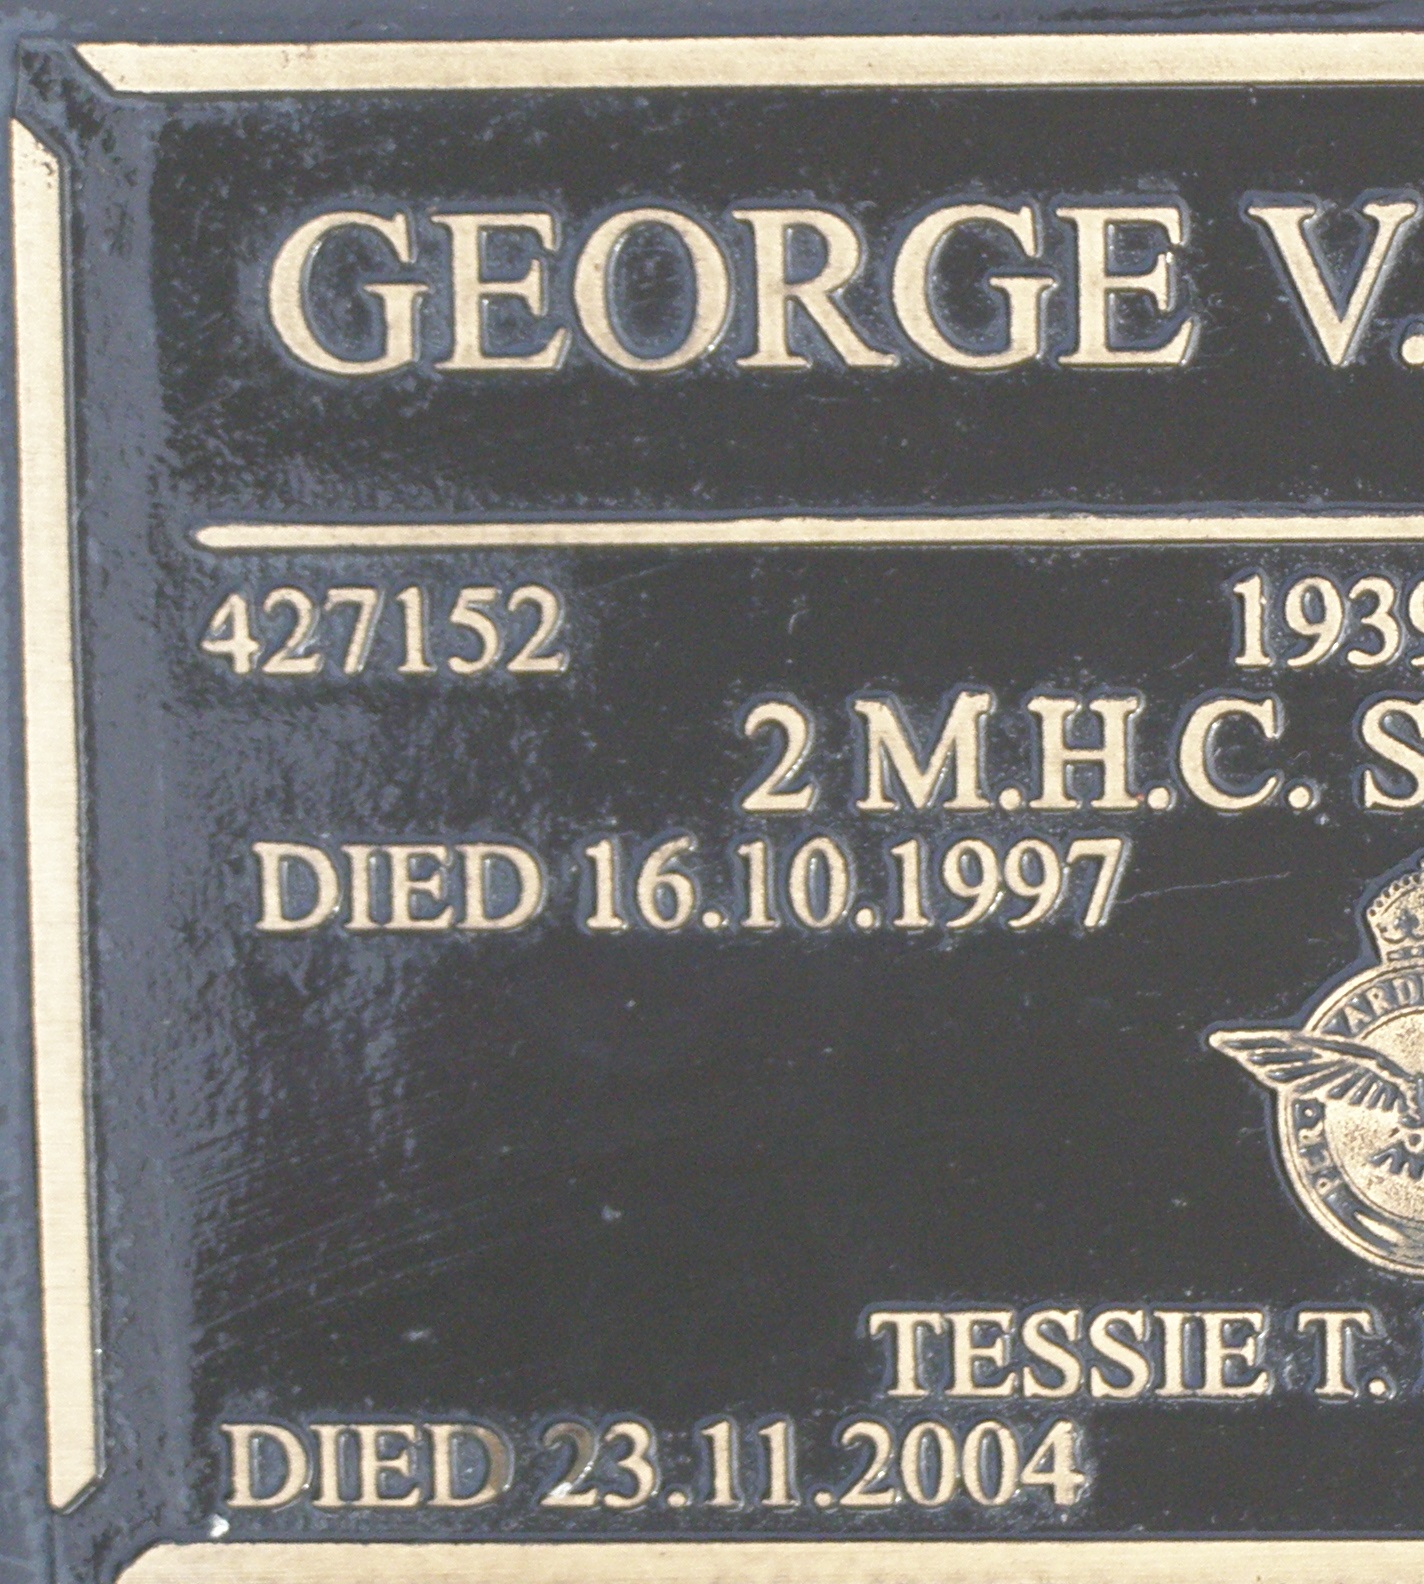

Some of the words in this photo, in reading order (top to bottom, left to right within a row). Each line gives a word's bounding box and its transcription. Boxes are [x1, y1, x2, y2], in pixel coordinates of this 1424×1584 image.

[268, 203, 1193, 375] GEORGE
[201, 585, 567, 675] 427152
[741, 701, 816, 812] 2
[854, 690, 1311, 812] M.H.C.
[252, 841, 542, 932] DIED
[585, 836, 1125, 930] 16.10.1997
[1299, 1121, 1340, 1198] PER
[868, 1308, 1275, 1399] TESSIE
[1297, 1310, 1387, 1397] T.
[221, 1421, 511, 1508] DIED
[541, 1420, 1091, 1508] 23.11.2004
